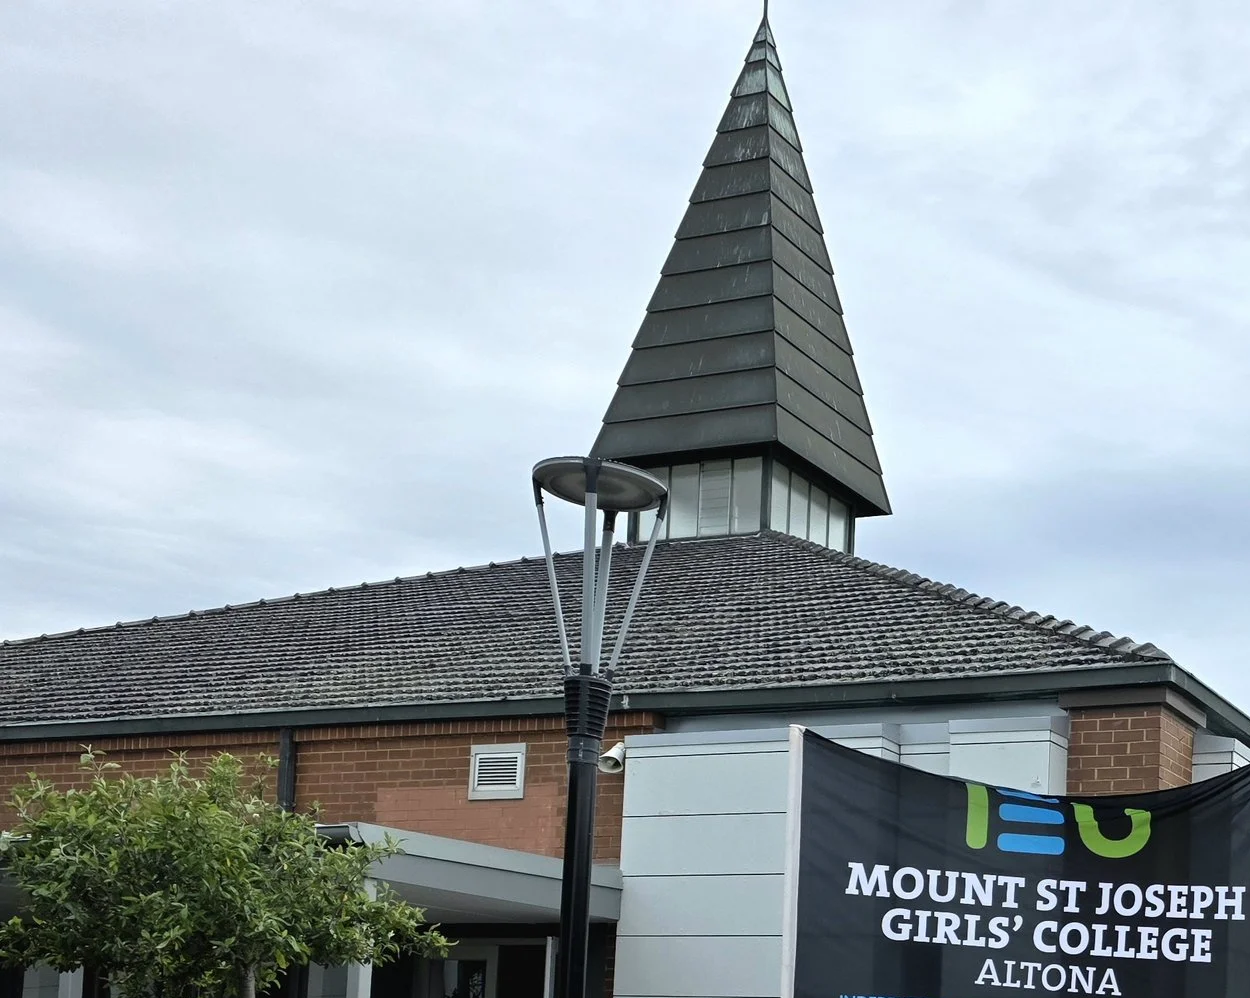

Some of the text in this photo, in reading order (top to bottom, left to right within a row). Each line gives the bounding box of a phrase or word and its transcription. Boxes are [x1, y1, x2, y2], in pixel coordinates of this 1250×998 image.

[965, 783, 1151, 858] IEU
[845, 862, 1246, 921] MOUNT ST JOSEPH
[1032, 921, 1212, 963] COLLEGE
[974, 959, 1122, 996] ALTONA
